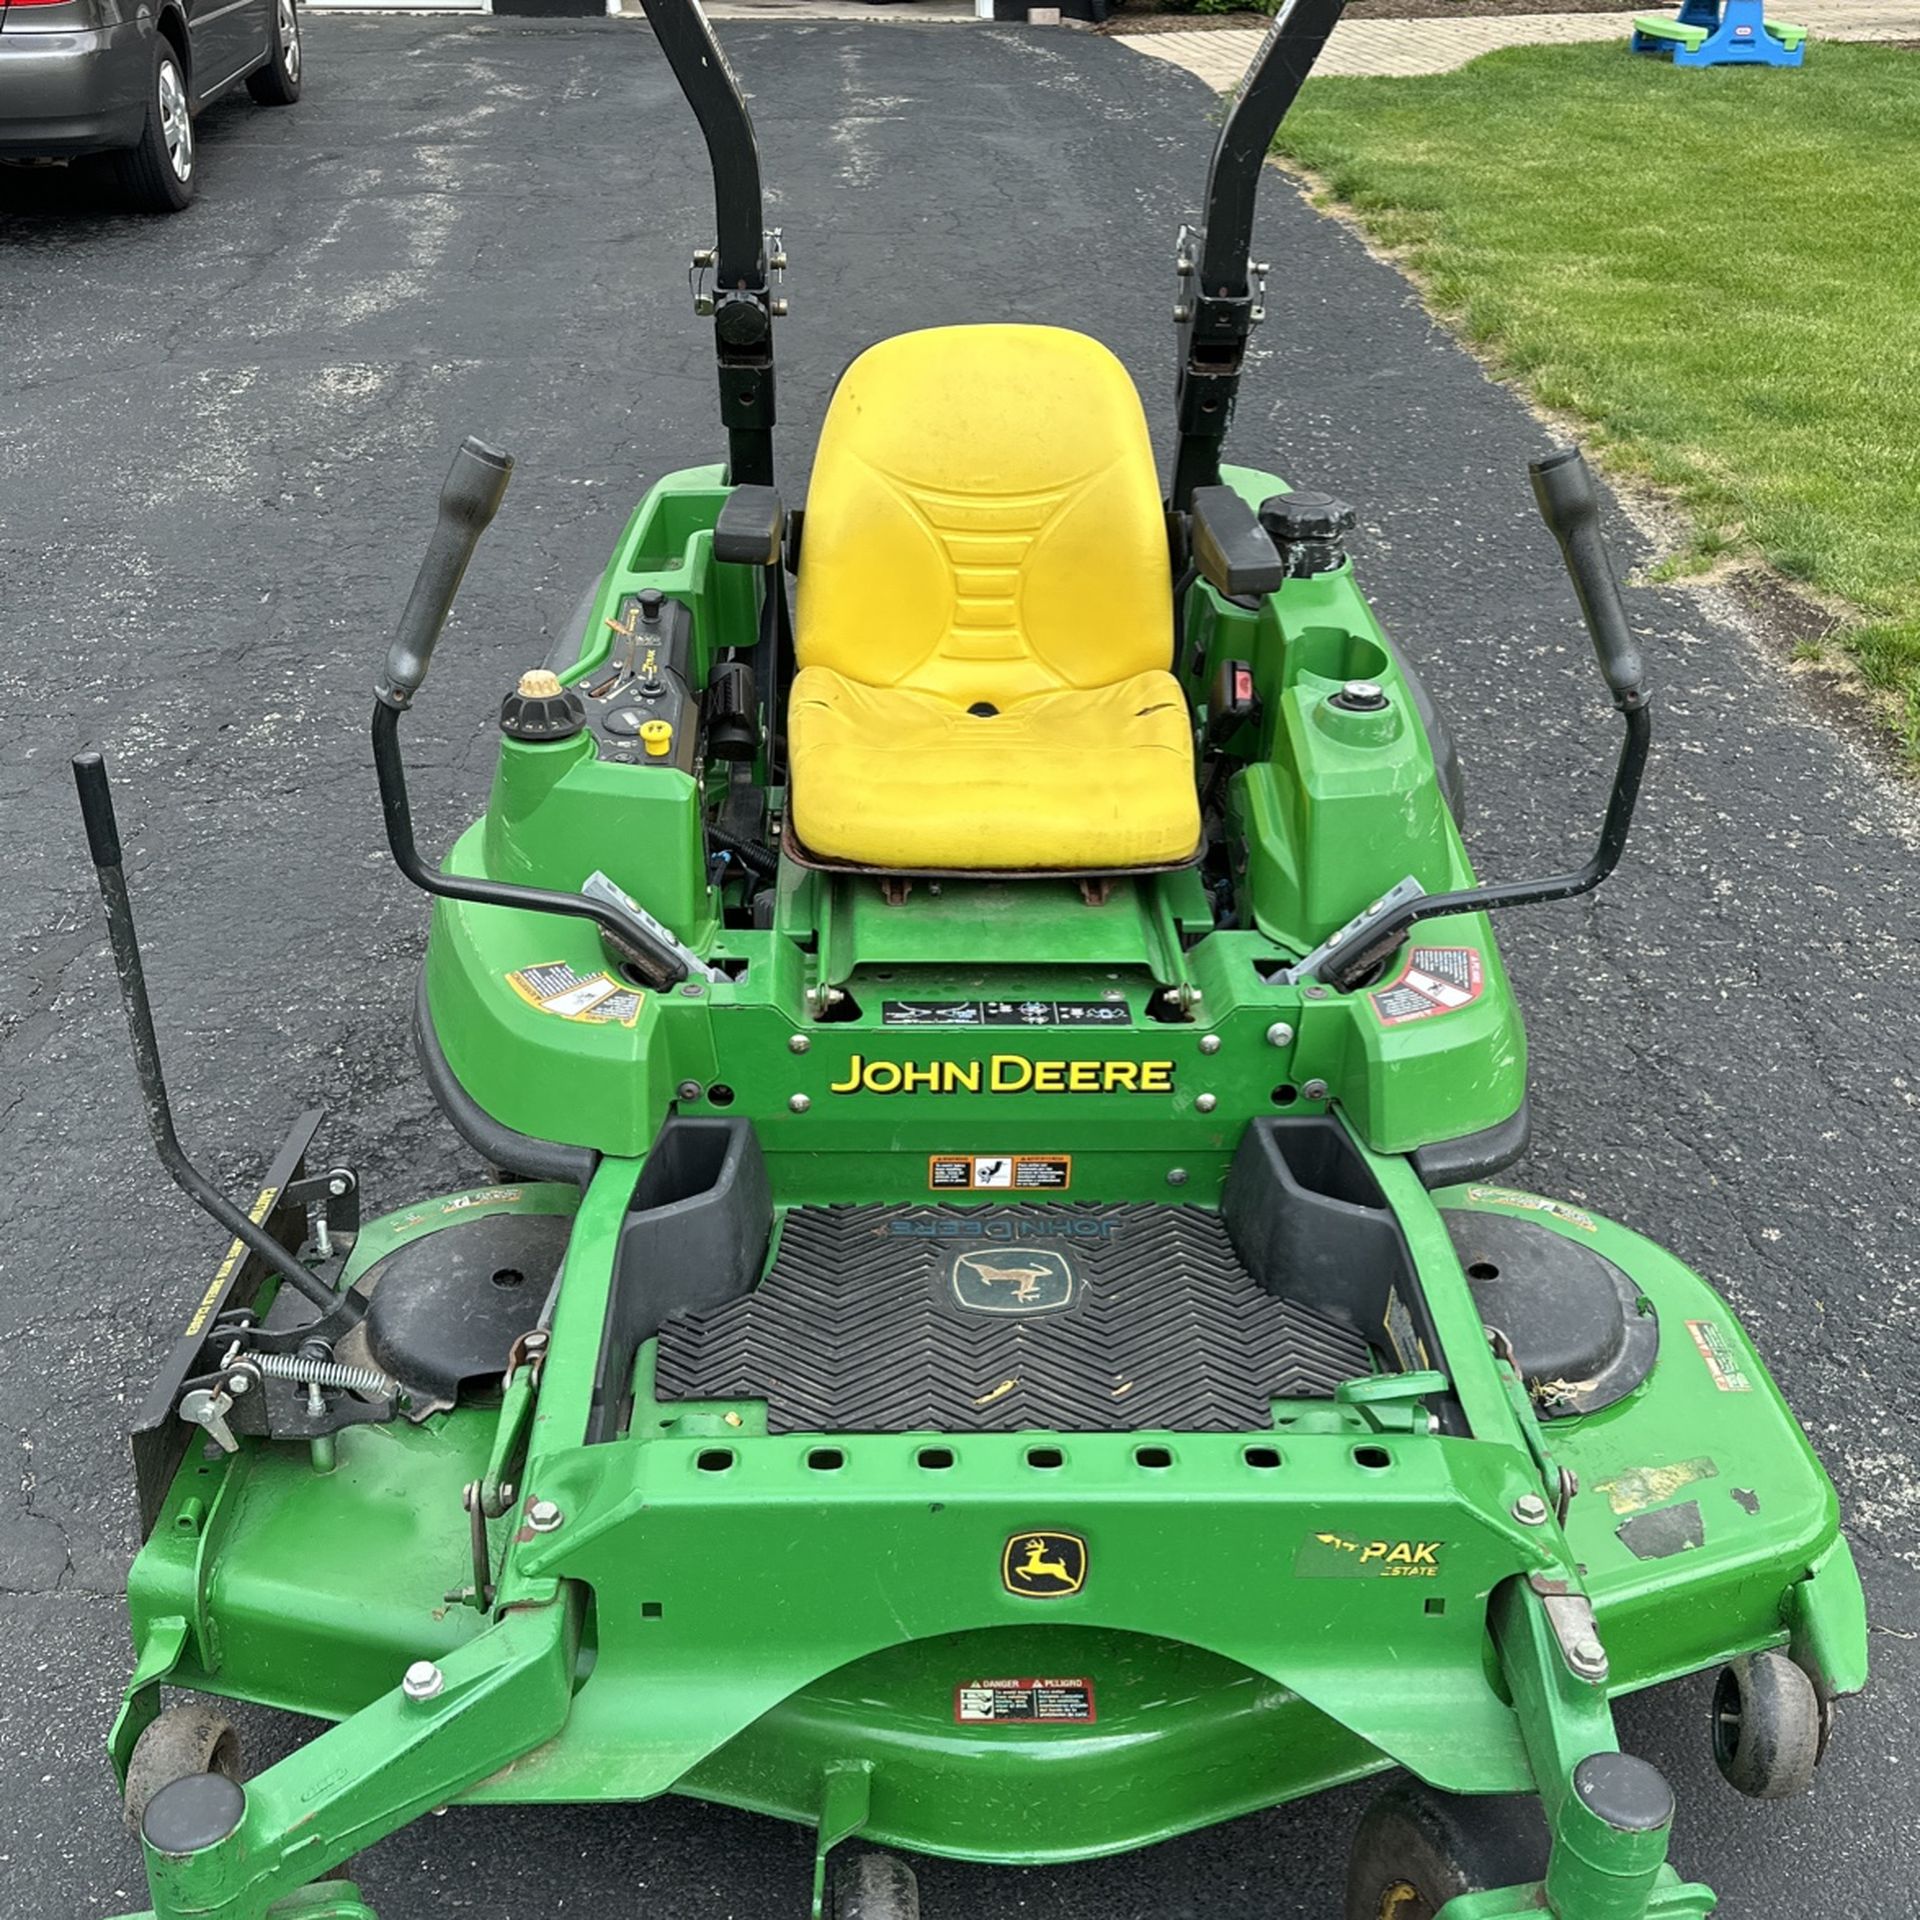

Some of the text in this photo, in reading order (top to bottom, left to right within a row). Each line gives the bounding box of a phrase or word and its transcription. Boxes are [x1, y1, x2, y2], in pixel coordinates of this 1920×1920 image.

[831, 1054, 1173, 1092] JOHN DEERE
[890, 1219, 1121, 1240] JOHN DEERE
[983, 1680, 1020, 1688] DANGER
